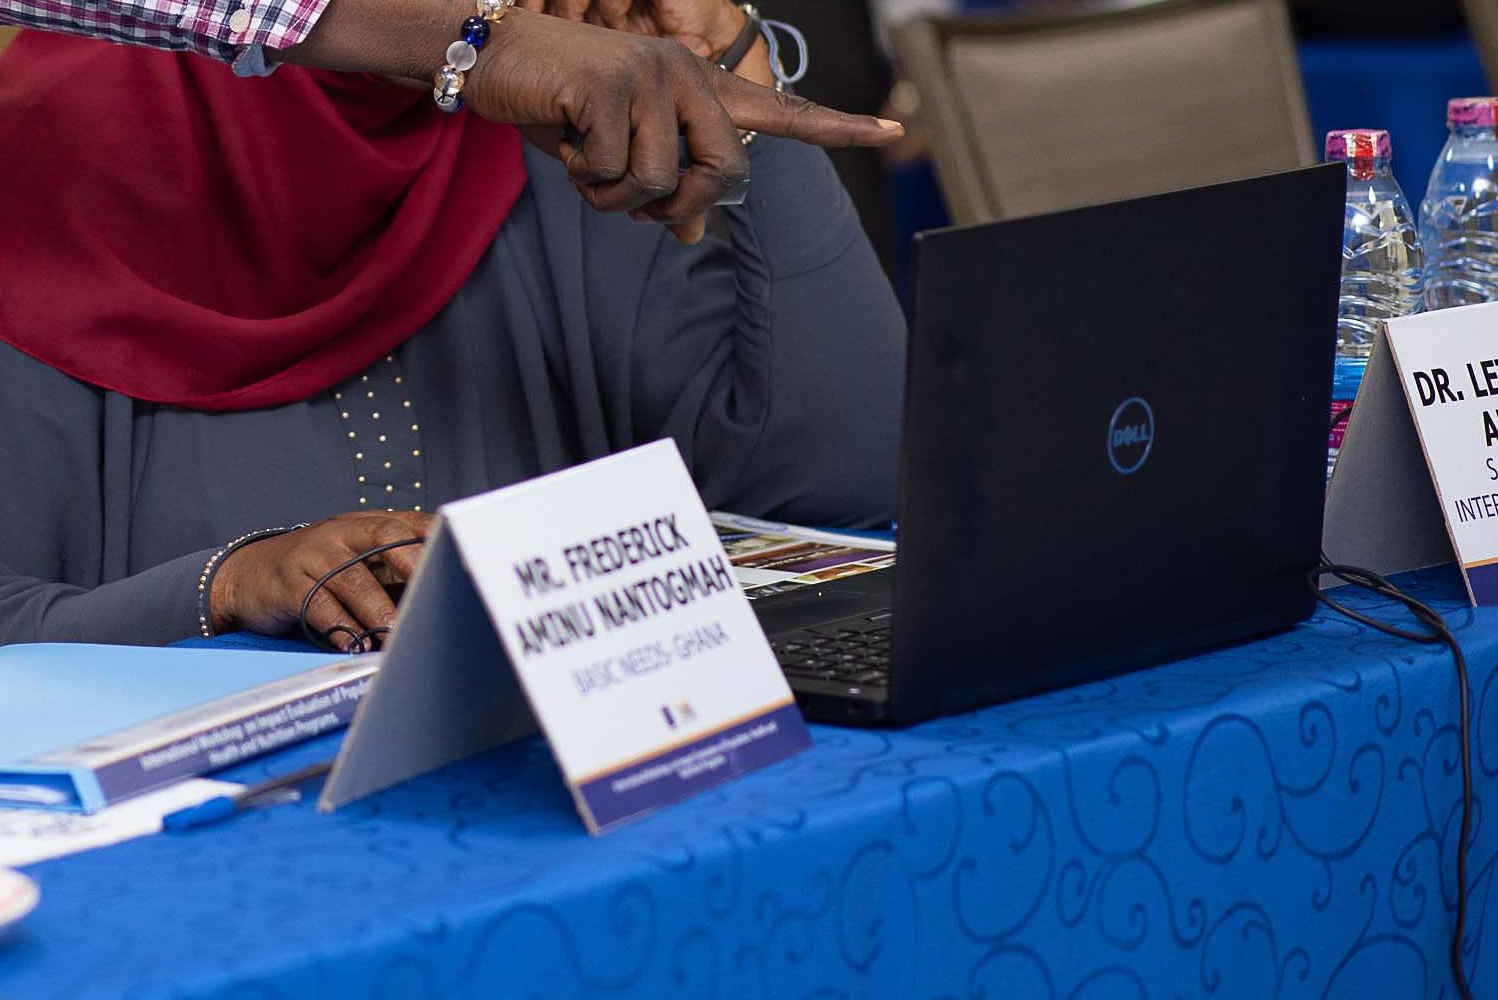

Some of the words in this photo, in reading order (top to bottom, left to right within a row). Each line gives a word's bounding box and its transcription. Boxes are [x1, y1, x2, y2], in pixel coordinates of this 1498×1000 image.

[1413, 368, 1465, 406] DR.
[1466, 359, 1498, 398] LE
[1483, 409, 1498, 446] A
[514, 557, 565, 597] MR.
[563, 513, 689, 583] FREDERICK
[515, 601, 595, 657] AMINU
[594, 555, 734, 630] NANTOGMAH
